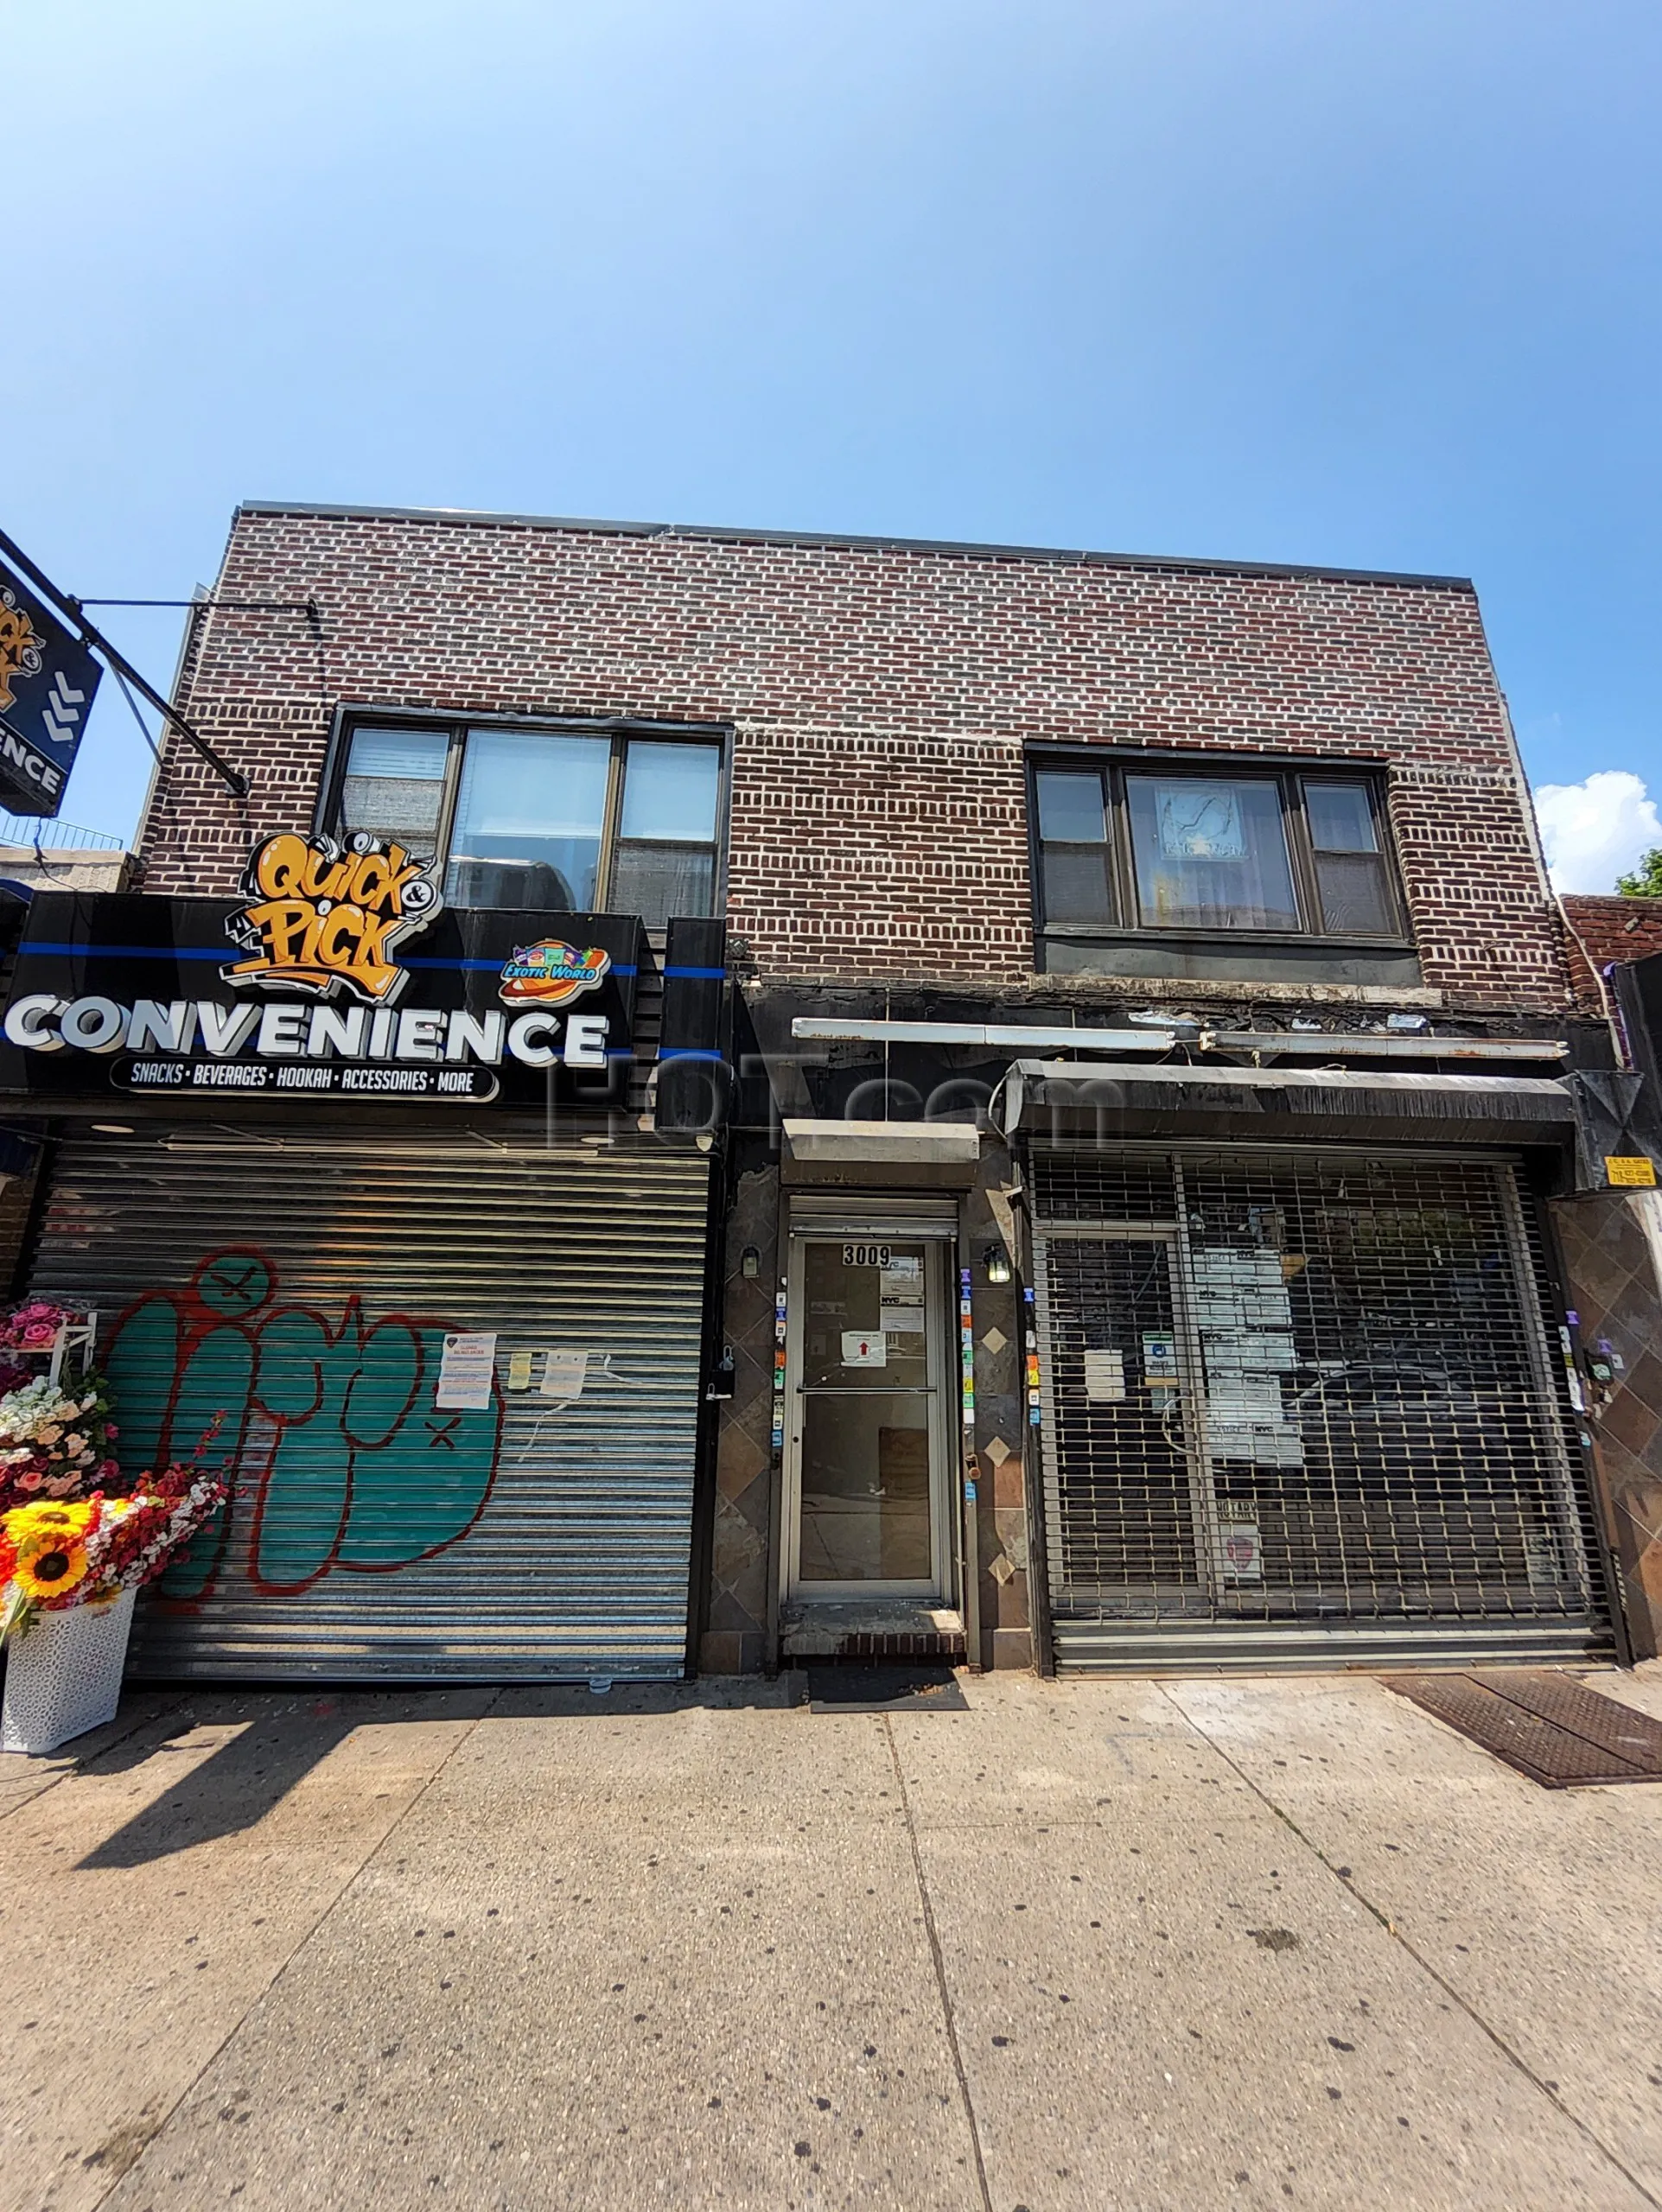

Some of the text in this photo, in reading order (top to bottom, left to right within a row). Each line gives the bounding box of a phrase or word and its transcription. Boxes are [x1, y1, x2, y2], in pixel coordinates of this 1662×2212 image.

[4, 995, 608, 1066] CONVENIENCE
[131, 1063, 473, 1092] SNACKS BEVERAGES HOOKAH ACCESSORIES MORE
[844, 1245, 889, 1266] 3009
